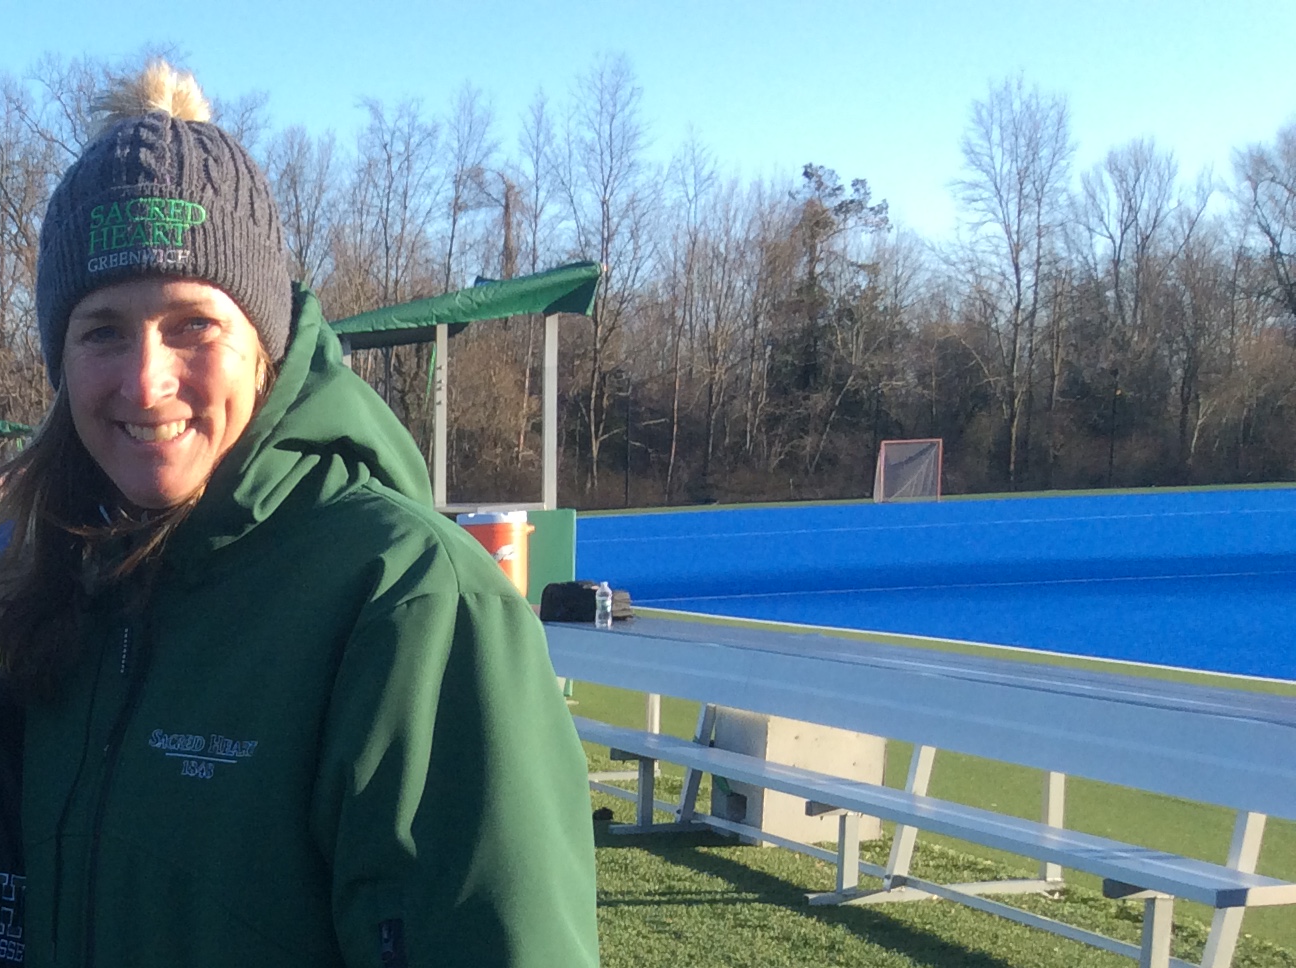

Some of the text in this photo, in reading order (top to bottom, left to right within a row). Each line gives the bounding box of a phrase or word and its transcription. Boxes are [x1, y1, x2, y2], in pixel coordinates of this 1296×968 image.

[90, 197, 207, 229] SACRED
[88, 222, 191, 256] HEART
[87, 249, 192, 273] GREENWICH
[148, 728, 259, 758] SACRED HEART
